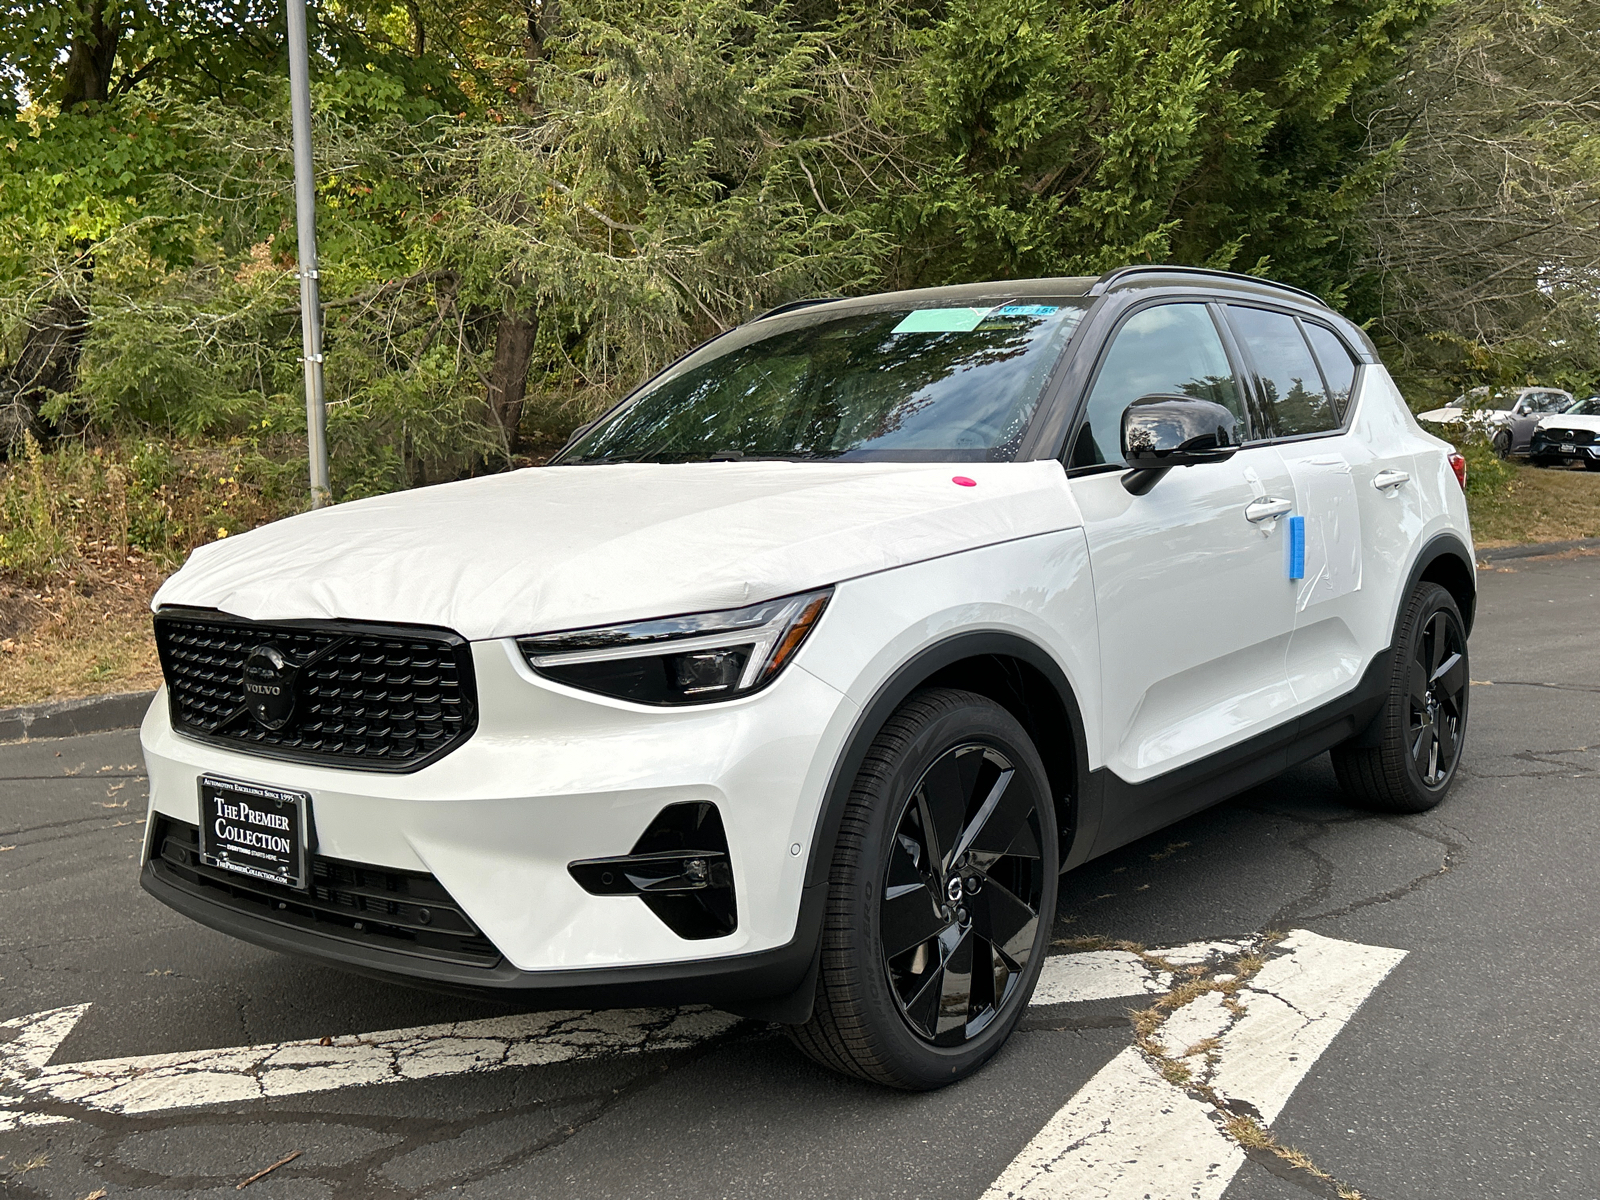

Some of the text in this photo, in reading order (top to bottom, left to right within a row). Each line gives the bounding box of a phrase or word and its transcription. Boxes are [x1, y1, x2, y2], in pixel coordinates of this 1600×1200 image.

[245, 683, 281, 696] VOLVO
[214, 797, 290, 831] THE PREMIER
[215, 818, 290, 854] COLLECTION
